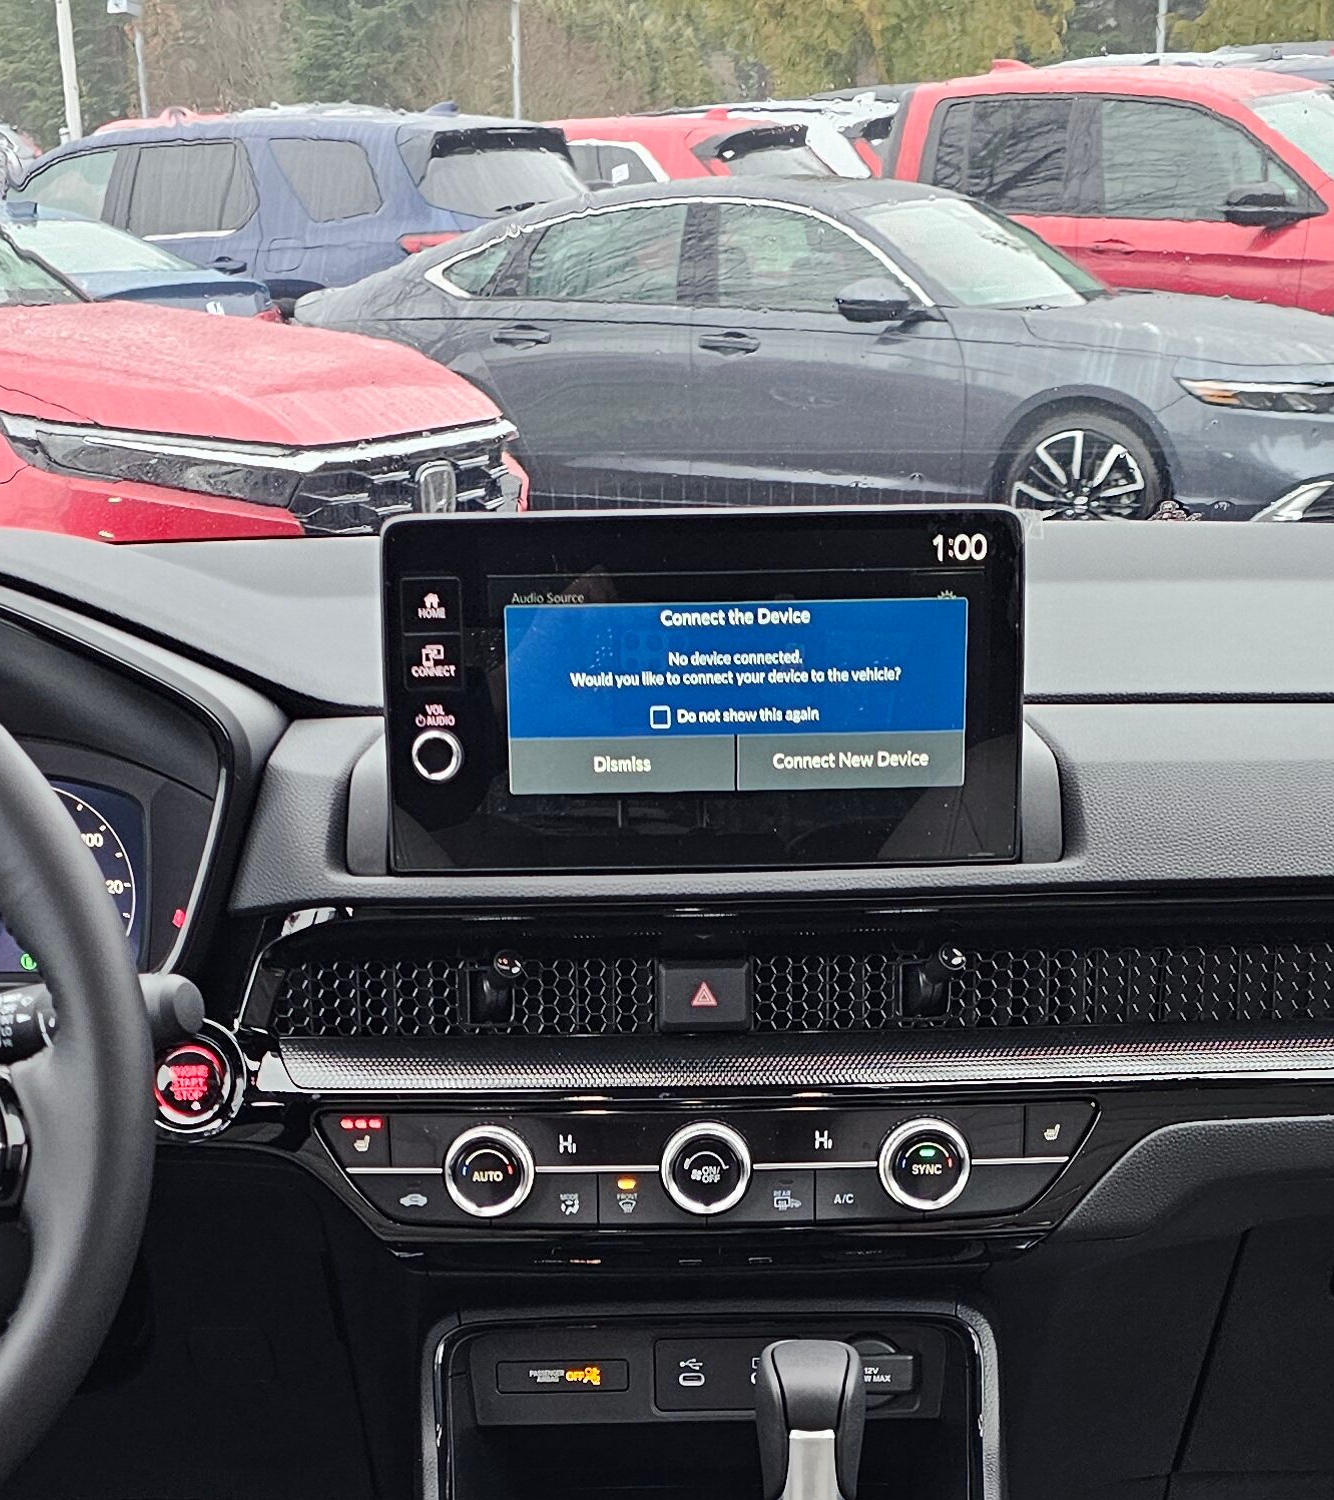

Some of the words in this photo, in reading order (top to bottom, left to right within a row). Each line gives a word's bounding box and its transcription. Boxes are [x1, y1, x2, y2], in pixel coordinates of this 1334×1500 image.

[932, 533, 988, 562] 1:00
[511, 593, 544, 604] Audio
[547, 592, 584, 604] Source
[418, 607, 446, 619] HOME
[660, 609, 726, 627] Connect
[728, 608, 754, 625] the
[757, 607, 811, 624] Device
[669, 652, 689, 666] No
[691, 650, 731, 666] device
[733, 649, 803, 665] connected.
[411, 665, 456, 677] CONNECT
[570, 672, 614, 688] Would
[615, 675, 639, 688] you
[642, 671, 664, 686] like
[666, 672, 681, 686] to
[683, 671, 733, 686] connect
[736, 671, 766, 687] your
[768, 668, 808, 684] device
[811, 669, 825, 683] to
[827, 667, 849, 682] the
[851, 667, 901, 682] vehicle?
[425, 704, 445, 715] VOL
[677, 709, 696, 724] Do
[699, 709, 720, 723] not
[723, 708, 757, 723] show
[759, 707, 783, 723] this
[785, 707, 819, 724] again
[427, 715, 456, 726] AUDIO
[593, 756, 652, 773] Dismiss
[772, 752, 836, 769] Connect
[839, 752, 873, 768] New
[877, 750, 929, 767] Device
[105, 879, 124, 895] 20
[171, 1077, 206, 1087] START
[174, 1090, 204, 1101] STOP
[912, 1164, 943, 1176] SYNC
[472, 1171, 504, 1182] AUTO
[701, 1174, 721, 1183] OFF
[833, 1193, 855, 1204] A/C
[566, 1370, 585, 1382] OFF
[872, 1374, 891, 1382] MAX
